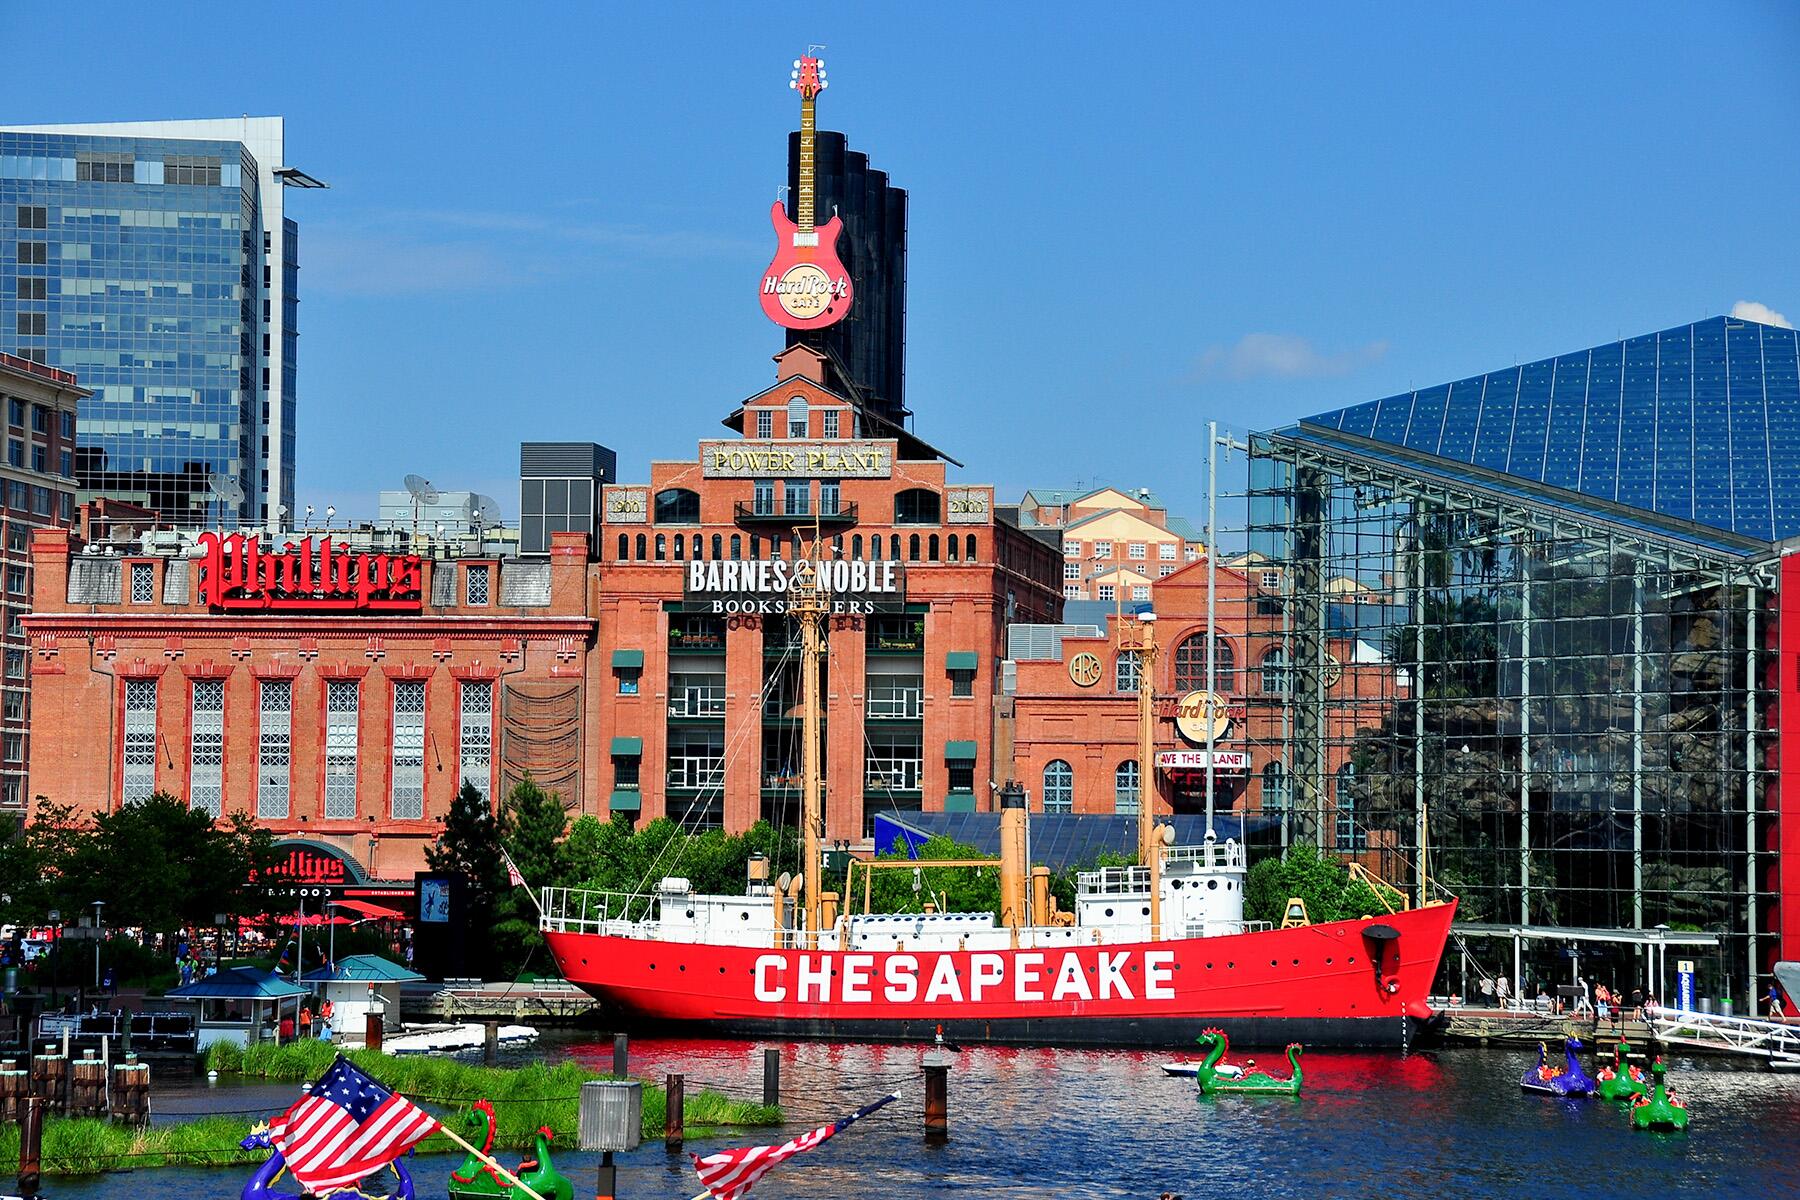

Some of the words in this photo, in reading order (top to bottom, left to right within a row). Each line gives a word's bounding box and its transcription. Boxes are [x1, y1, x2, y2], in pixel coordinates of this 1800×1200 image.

[763, 275, 806, 295] Hard
[806, 275, 848, 298] Rock
[713, 451, 796, 471] POWER
[807, 451, 884, 472] PLANT
[951, 500, 985, 514] 2000
[198, 532, 422, 609] Phillips
[690, 560, 787, 592] BARNES
[817, 560, 896, 592] NOBLE
[712, 600, 874, 614] BOOKSELERS
[1161, 754, 1177, 764] AVE
[1182, 754, 1201, 763] THE
[1213, 754, 1243, 764] LANET
[753, 950, 1176, 1003] CHESAPEAKE
